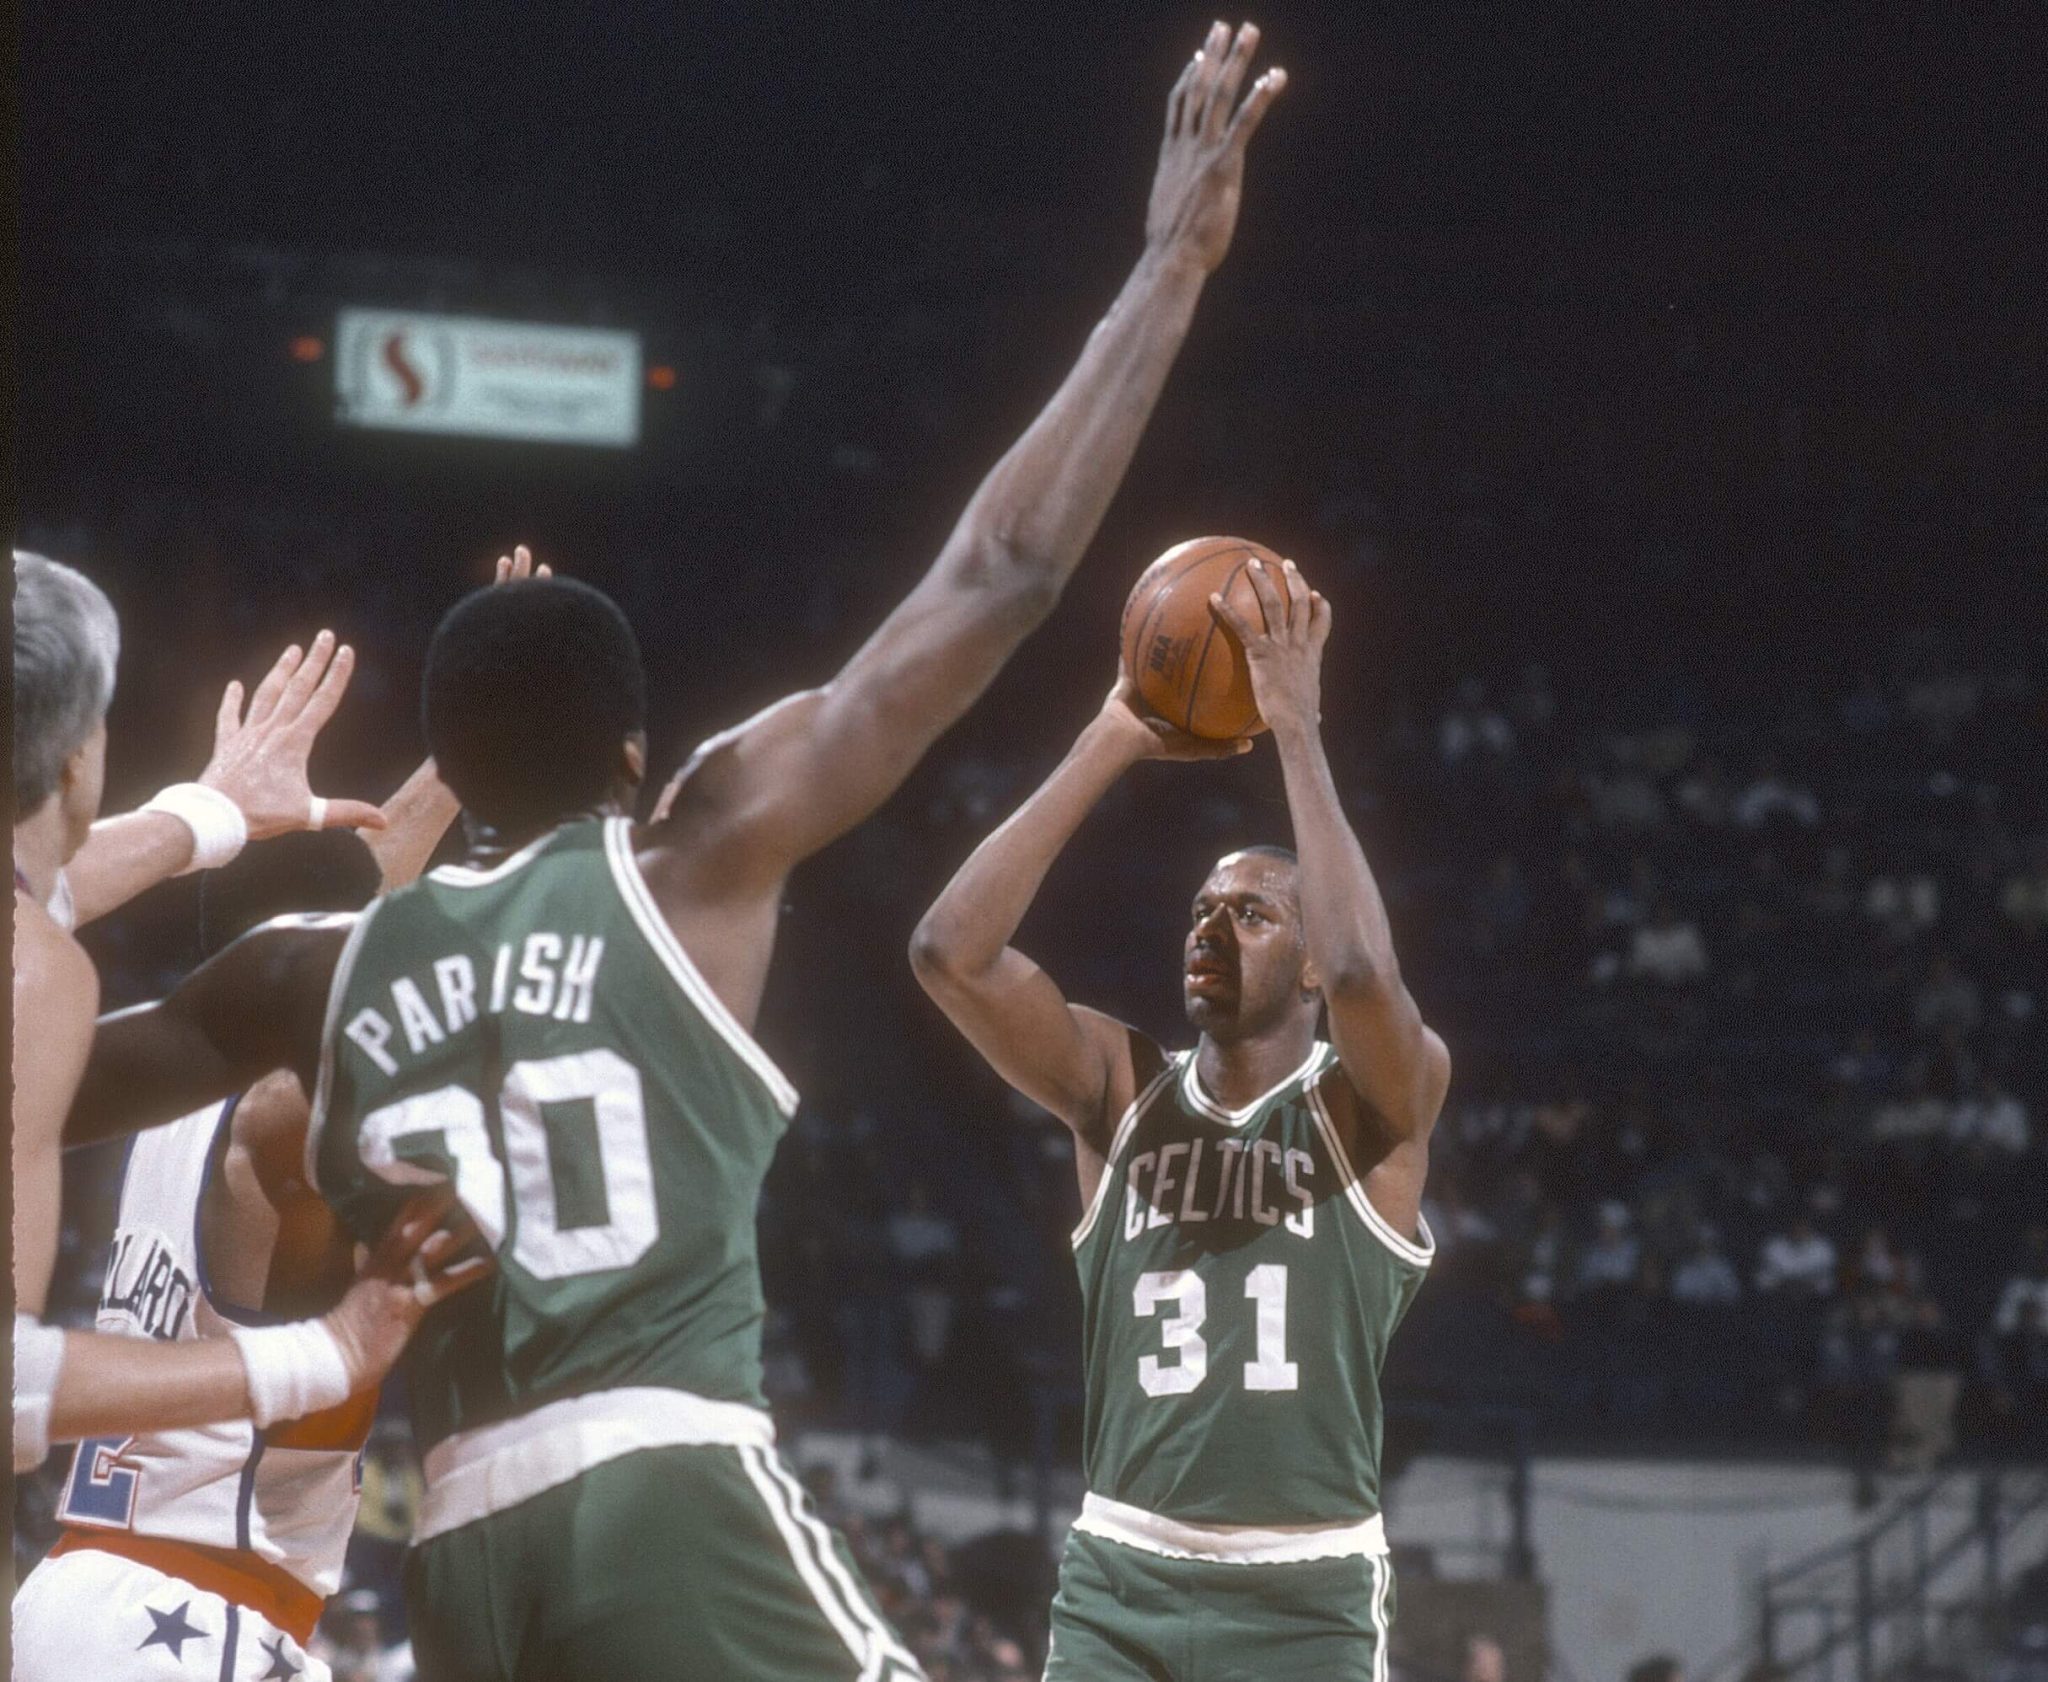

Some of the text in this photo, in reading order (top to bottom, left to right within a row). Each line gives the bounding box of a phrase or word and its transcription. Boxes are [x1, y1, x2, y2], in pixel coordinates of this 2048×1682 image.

[345, 932, 604, 1077] PARISH
[1124, 1138, 1315, 1242] CELTICS
[1133, 1264, 1299, 1398] 31
